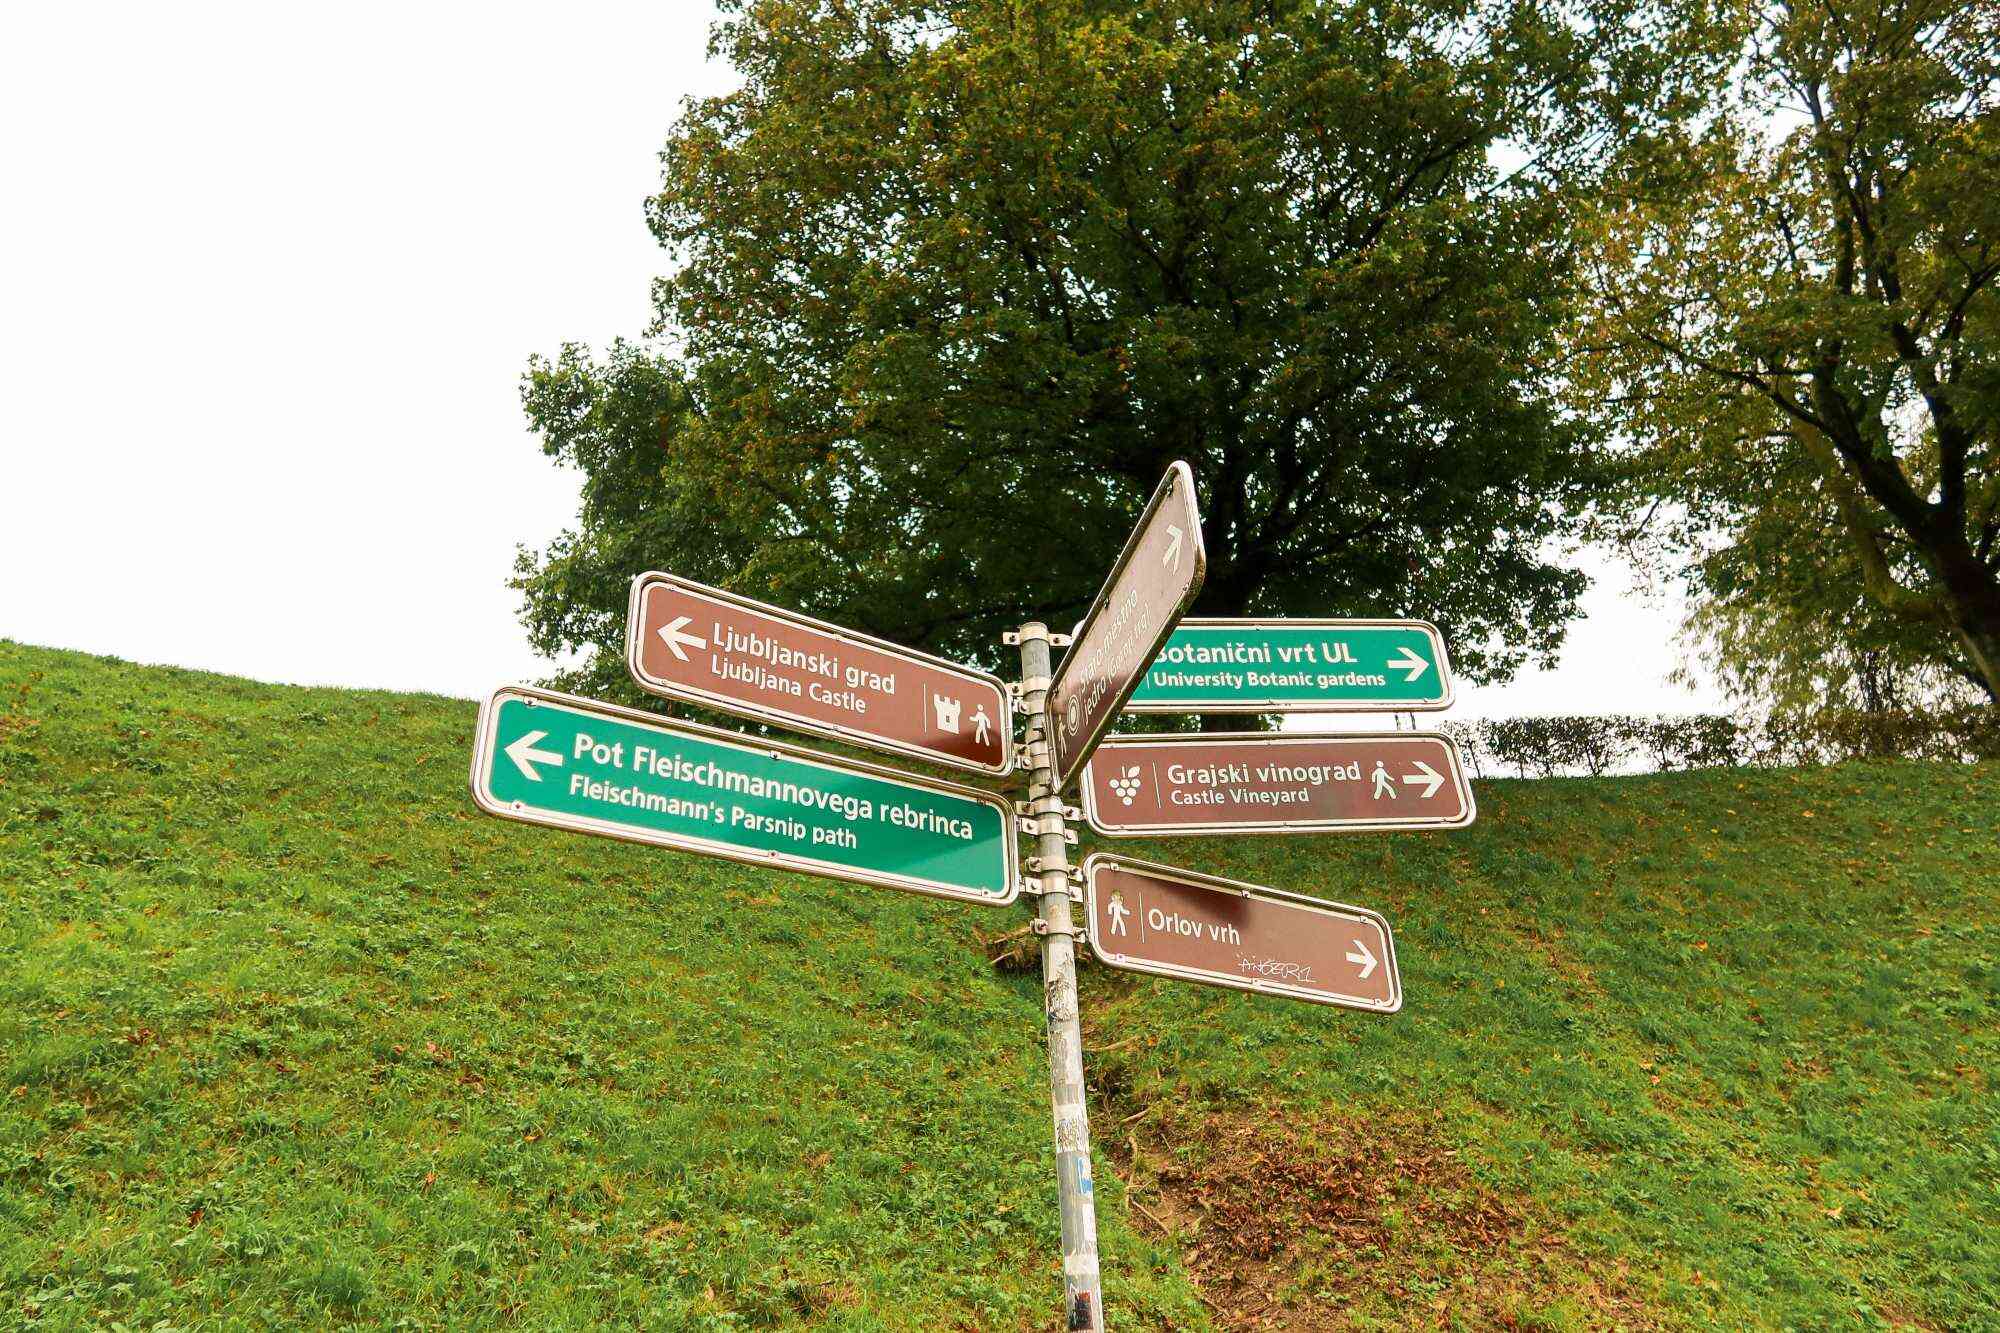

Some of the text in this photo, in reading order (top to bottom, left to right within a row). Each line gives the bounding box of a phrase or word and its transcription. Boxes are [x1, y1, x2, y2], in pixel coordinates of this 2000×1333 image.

[712, 622, 895, 696] Ljubljanski grad
[1277, 643, 1317, 663] vrt
[1322, 641, 1358, 663] UL
[711, 654, 867, 714] Ljubljana Castle
[1083, 675, 1107, 727] jedro
[1153, 671, 1386, 689] University Botanic gardens
[573, 732, 974, 841] Pot Fleischmannovega rebrinca
[1167, 760, 1362, 788] Grajski vinograd
[569, 772, 858, 850] Fleischmann's Parsnip path
[1170, 787, 1309, 807] Castle Vineyard
[1148, 908, 1241, 946] Orlov vrh
